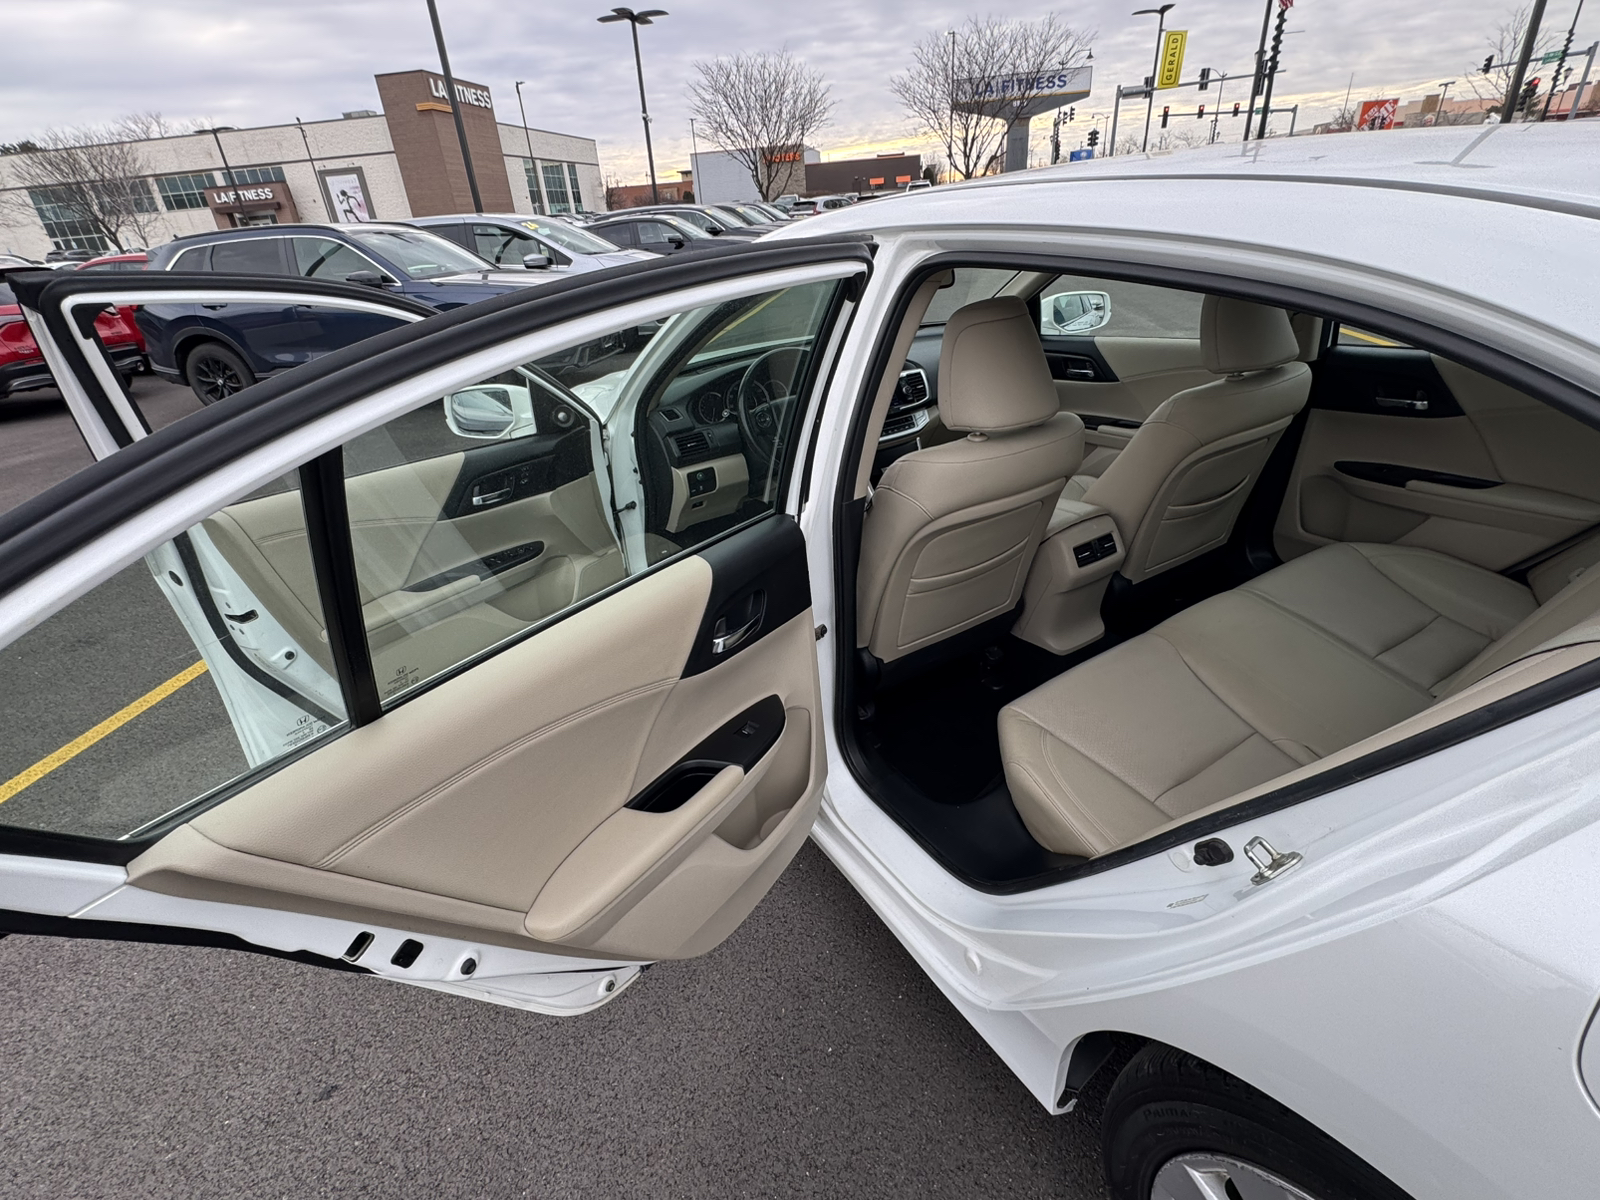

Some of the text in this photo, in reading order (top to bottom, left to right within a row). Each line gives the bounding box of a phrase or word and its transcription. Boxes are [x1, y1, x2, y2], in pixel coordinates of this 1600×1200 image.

[1165, 37, 1179, 81] GERALD
[429, 77, 492, 109] LA ITNESS
[975, 74, 1068, 97] LA FITNESS
[213, 188, 273, 204] LA FTNESS
